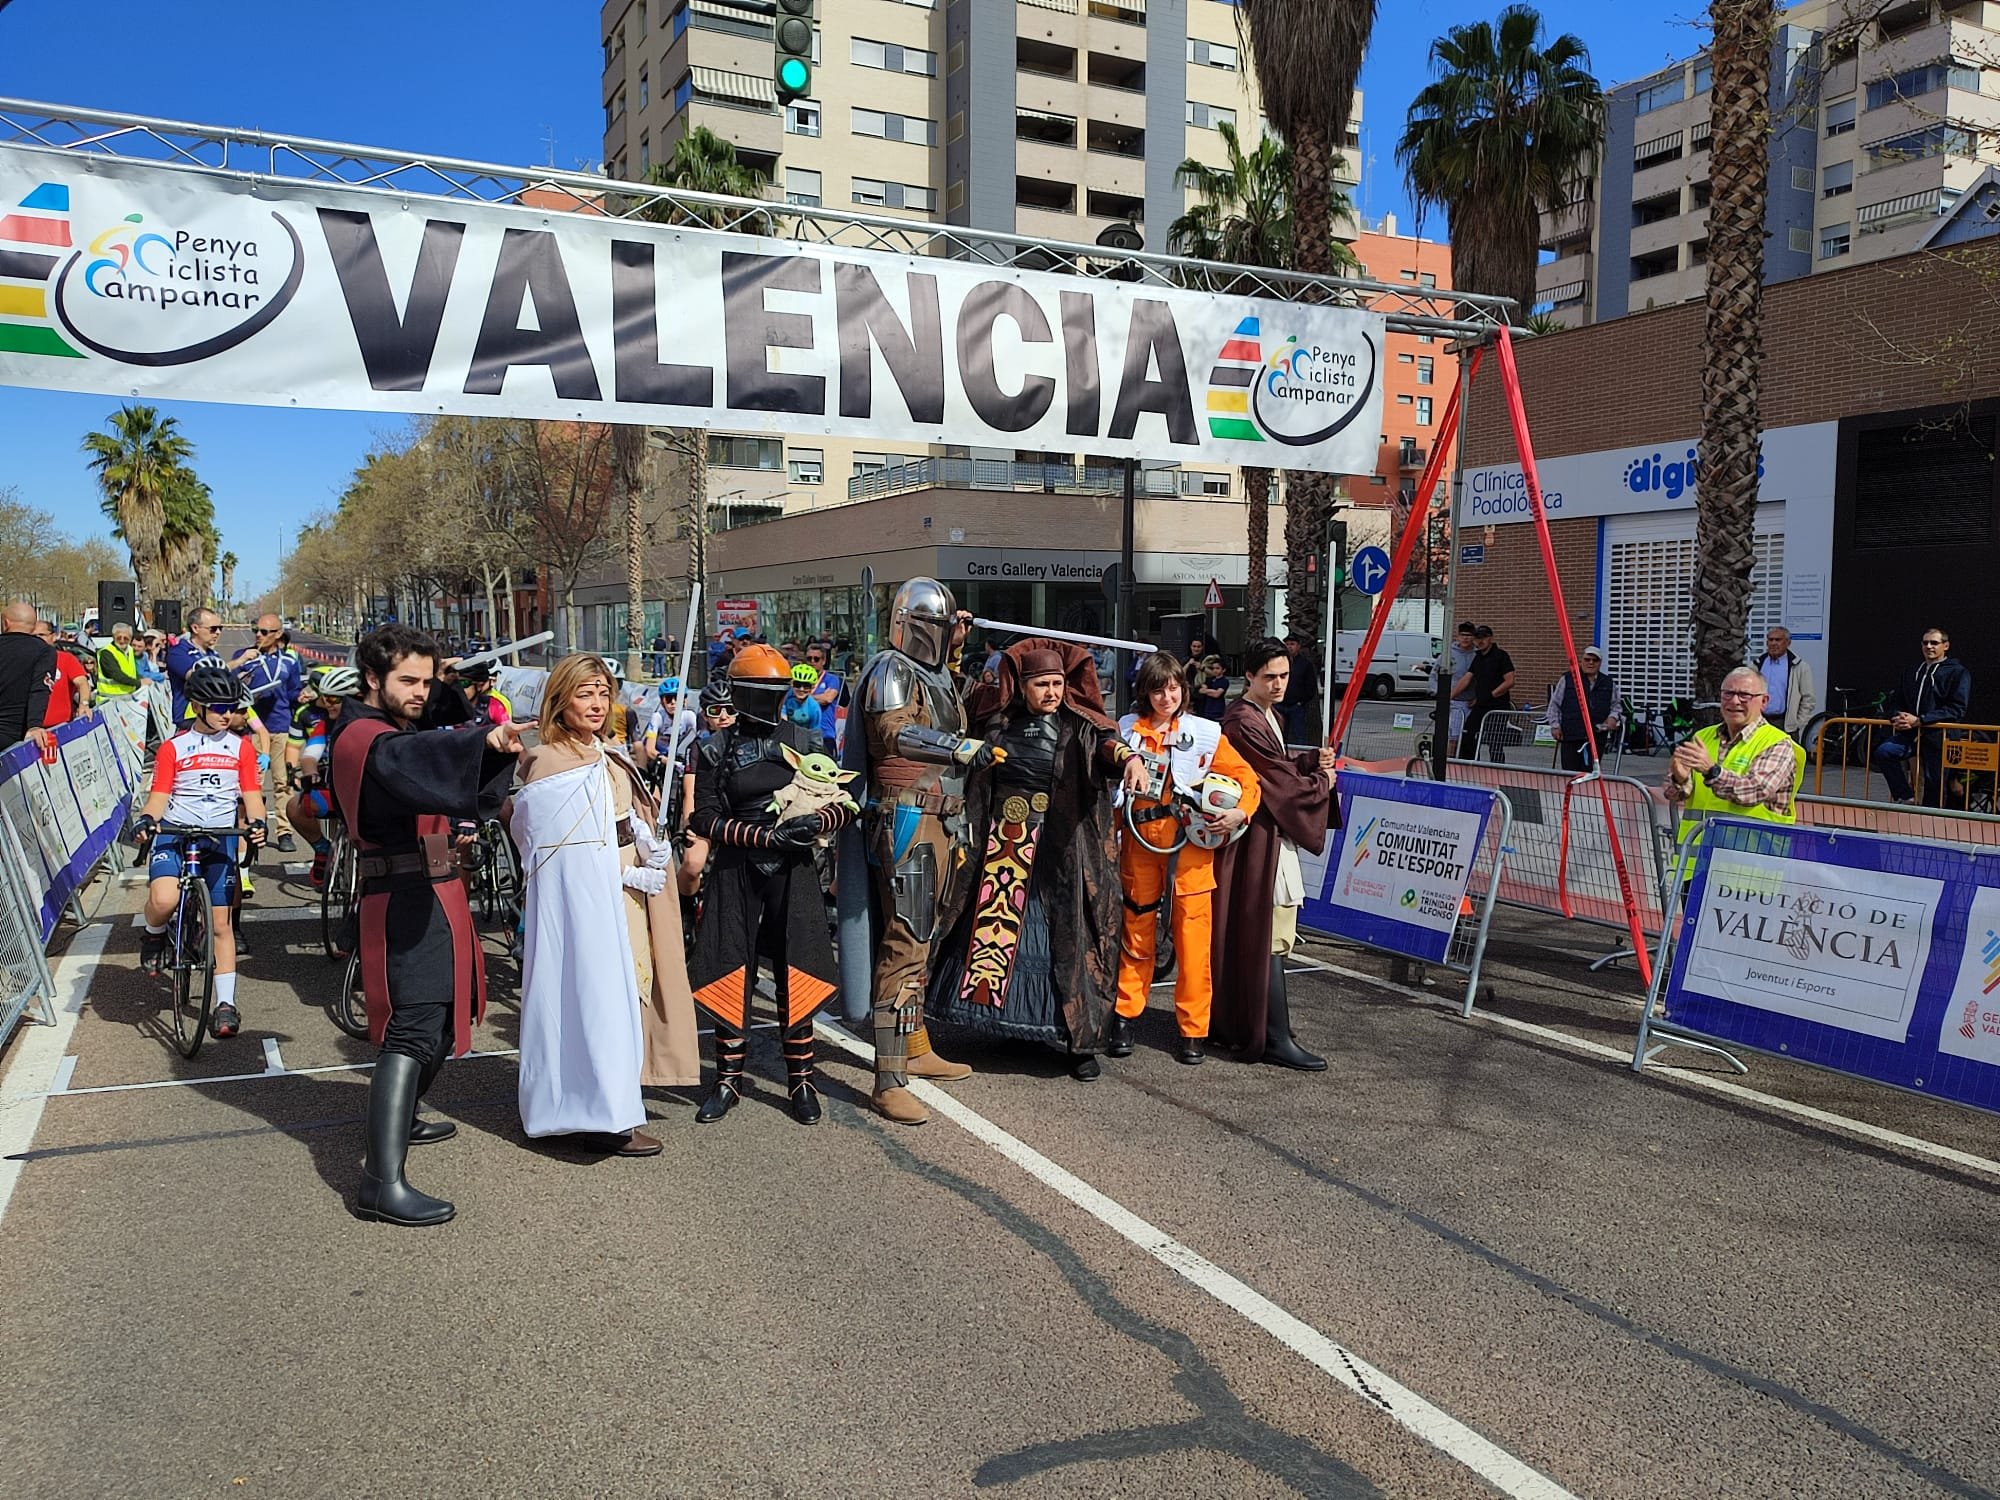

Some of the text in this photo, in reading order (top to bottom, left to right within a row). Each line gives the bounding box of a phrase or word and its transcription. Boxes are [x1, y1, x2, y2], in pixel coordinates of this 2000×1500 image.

[175, 230, 259, 262] Penya
[316, 206, 1200, 445] VALENCIA
[1312, 346, 1356, 369] Penya
[1472, 470, 1524, 493] Clínica
[967, 561, 1103, 579] Cars Gallery Valencia
[200, 773, 220, 786] FG
[1380, 817, 1460, 841] Comunitat Valenciana
[1376, 831, 1458, 861] COMUNITAT
[1378, 850, 1464, 881] DE L'ESPORT
[1418, 906, 1453, 920] ALFONSO
[1421, 896, 1455, 911] TRINIDAD
[1717, 884, 1907, 929] DIPUTACIÓ DE
[1713, 907, 1903, 969] VALÈNCIA
[1745, 968, 1790, 988] Joventut
[1796, 978, 1836, 997] Esports
